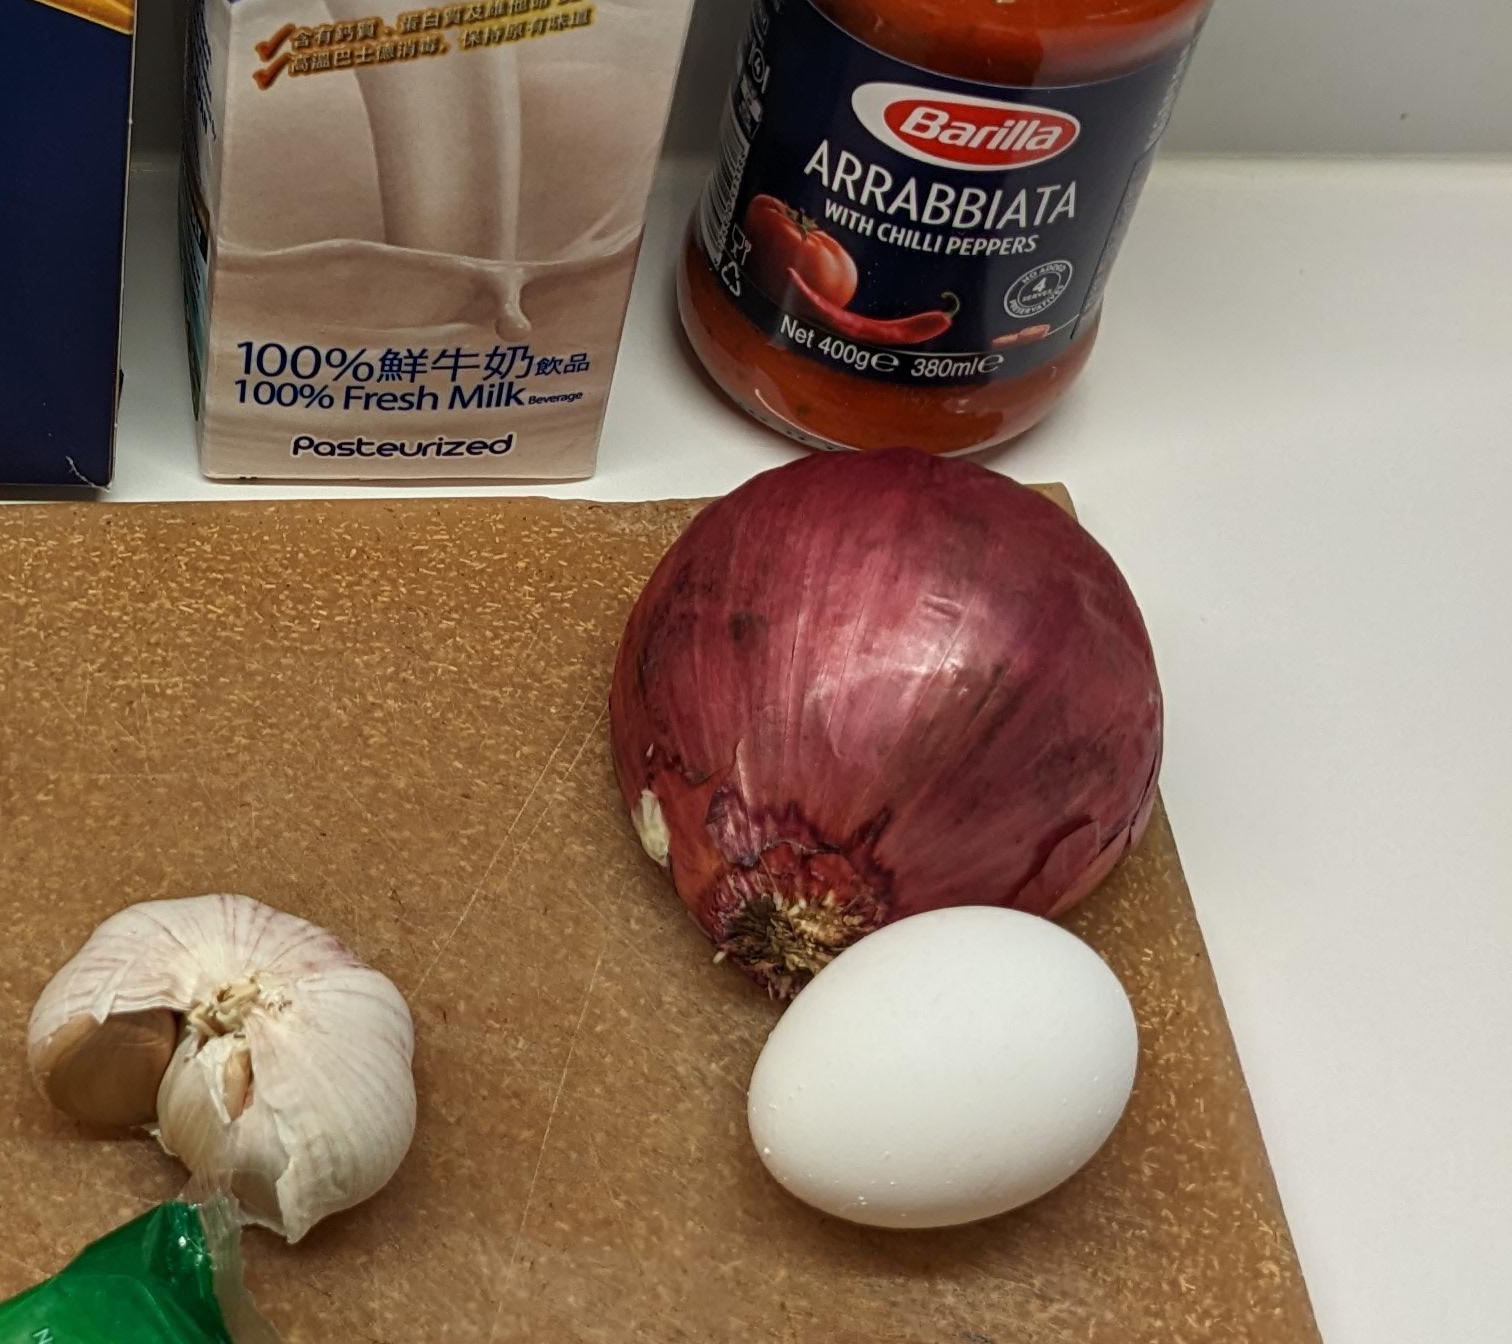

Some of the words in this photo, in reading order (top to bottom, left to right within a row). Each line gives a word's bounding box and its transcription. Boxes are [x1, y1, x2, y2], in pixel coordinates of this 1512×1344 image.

[898, 105, 1064, 154] Barilla
[803, 139, 1079, 231] ARRABBIATA
[824, 198, 875, 237] WITH
[876, 222, 944, 254] CHILLI
[944, 233, 1040, 257] PEPPERS
[1031, 276, 1047, 293] 4
[779, 314, 815, 350] Net
[234, 378, 335, 410] 100%
[342, 383, 439, 412] Fresh
[447, 381, 526, 411] Milk
[527, 390, 584, 406] Beverage
[291, 432, 515, 458] Pasteurized
